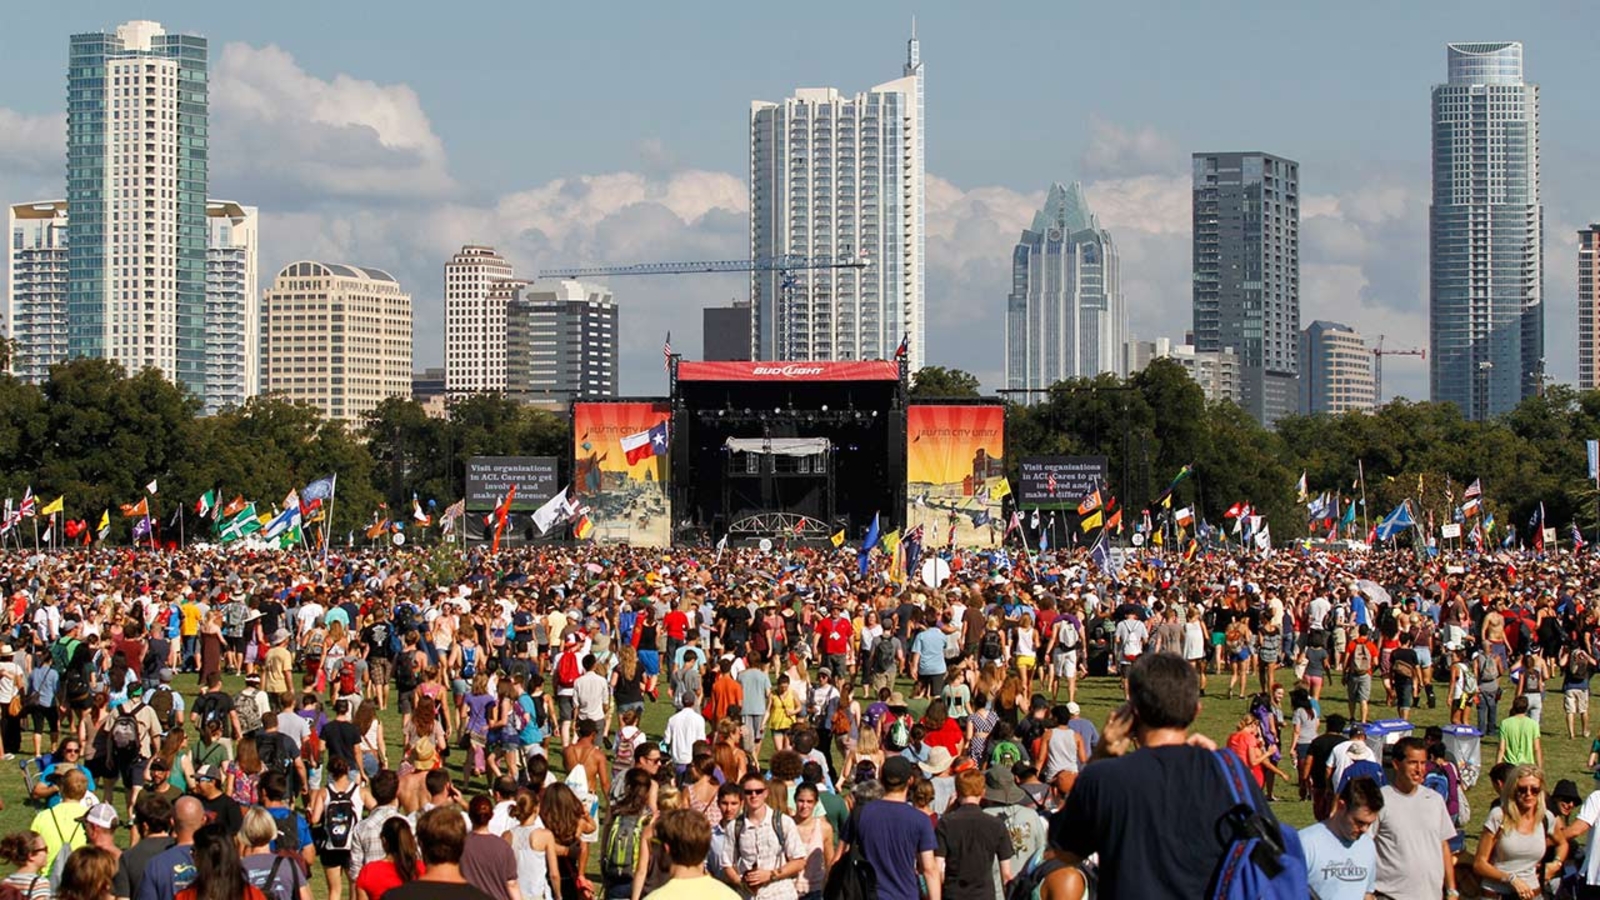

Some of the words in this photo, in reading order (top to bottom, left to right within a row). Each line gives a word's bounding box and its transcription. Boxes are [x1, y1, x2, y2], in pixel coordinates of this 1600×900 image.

[753, 367, 782, 375] BUD
[788, 367, 824, 375] LIGHT
[620, 426, 638, 434] CITY
[952, 429, 970, 437] CITY
[471, 464, 491, 472] Visit
[494, 464, 552, 473] organizations
[1044, 464, 1101, 472] organizations
[539, 474, 553, 482] get
[1025, 491, 1047, 499] make
